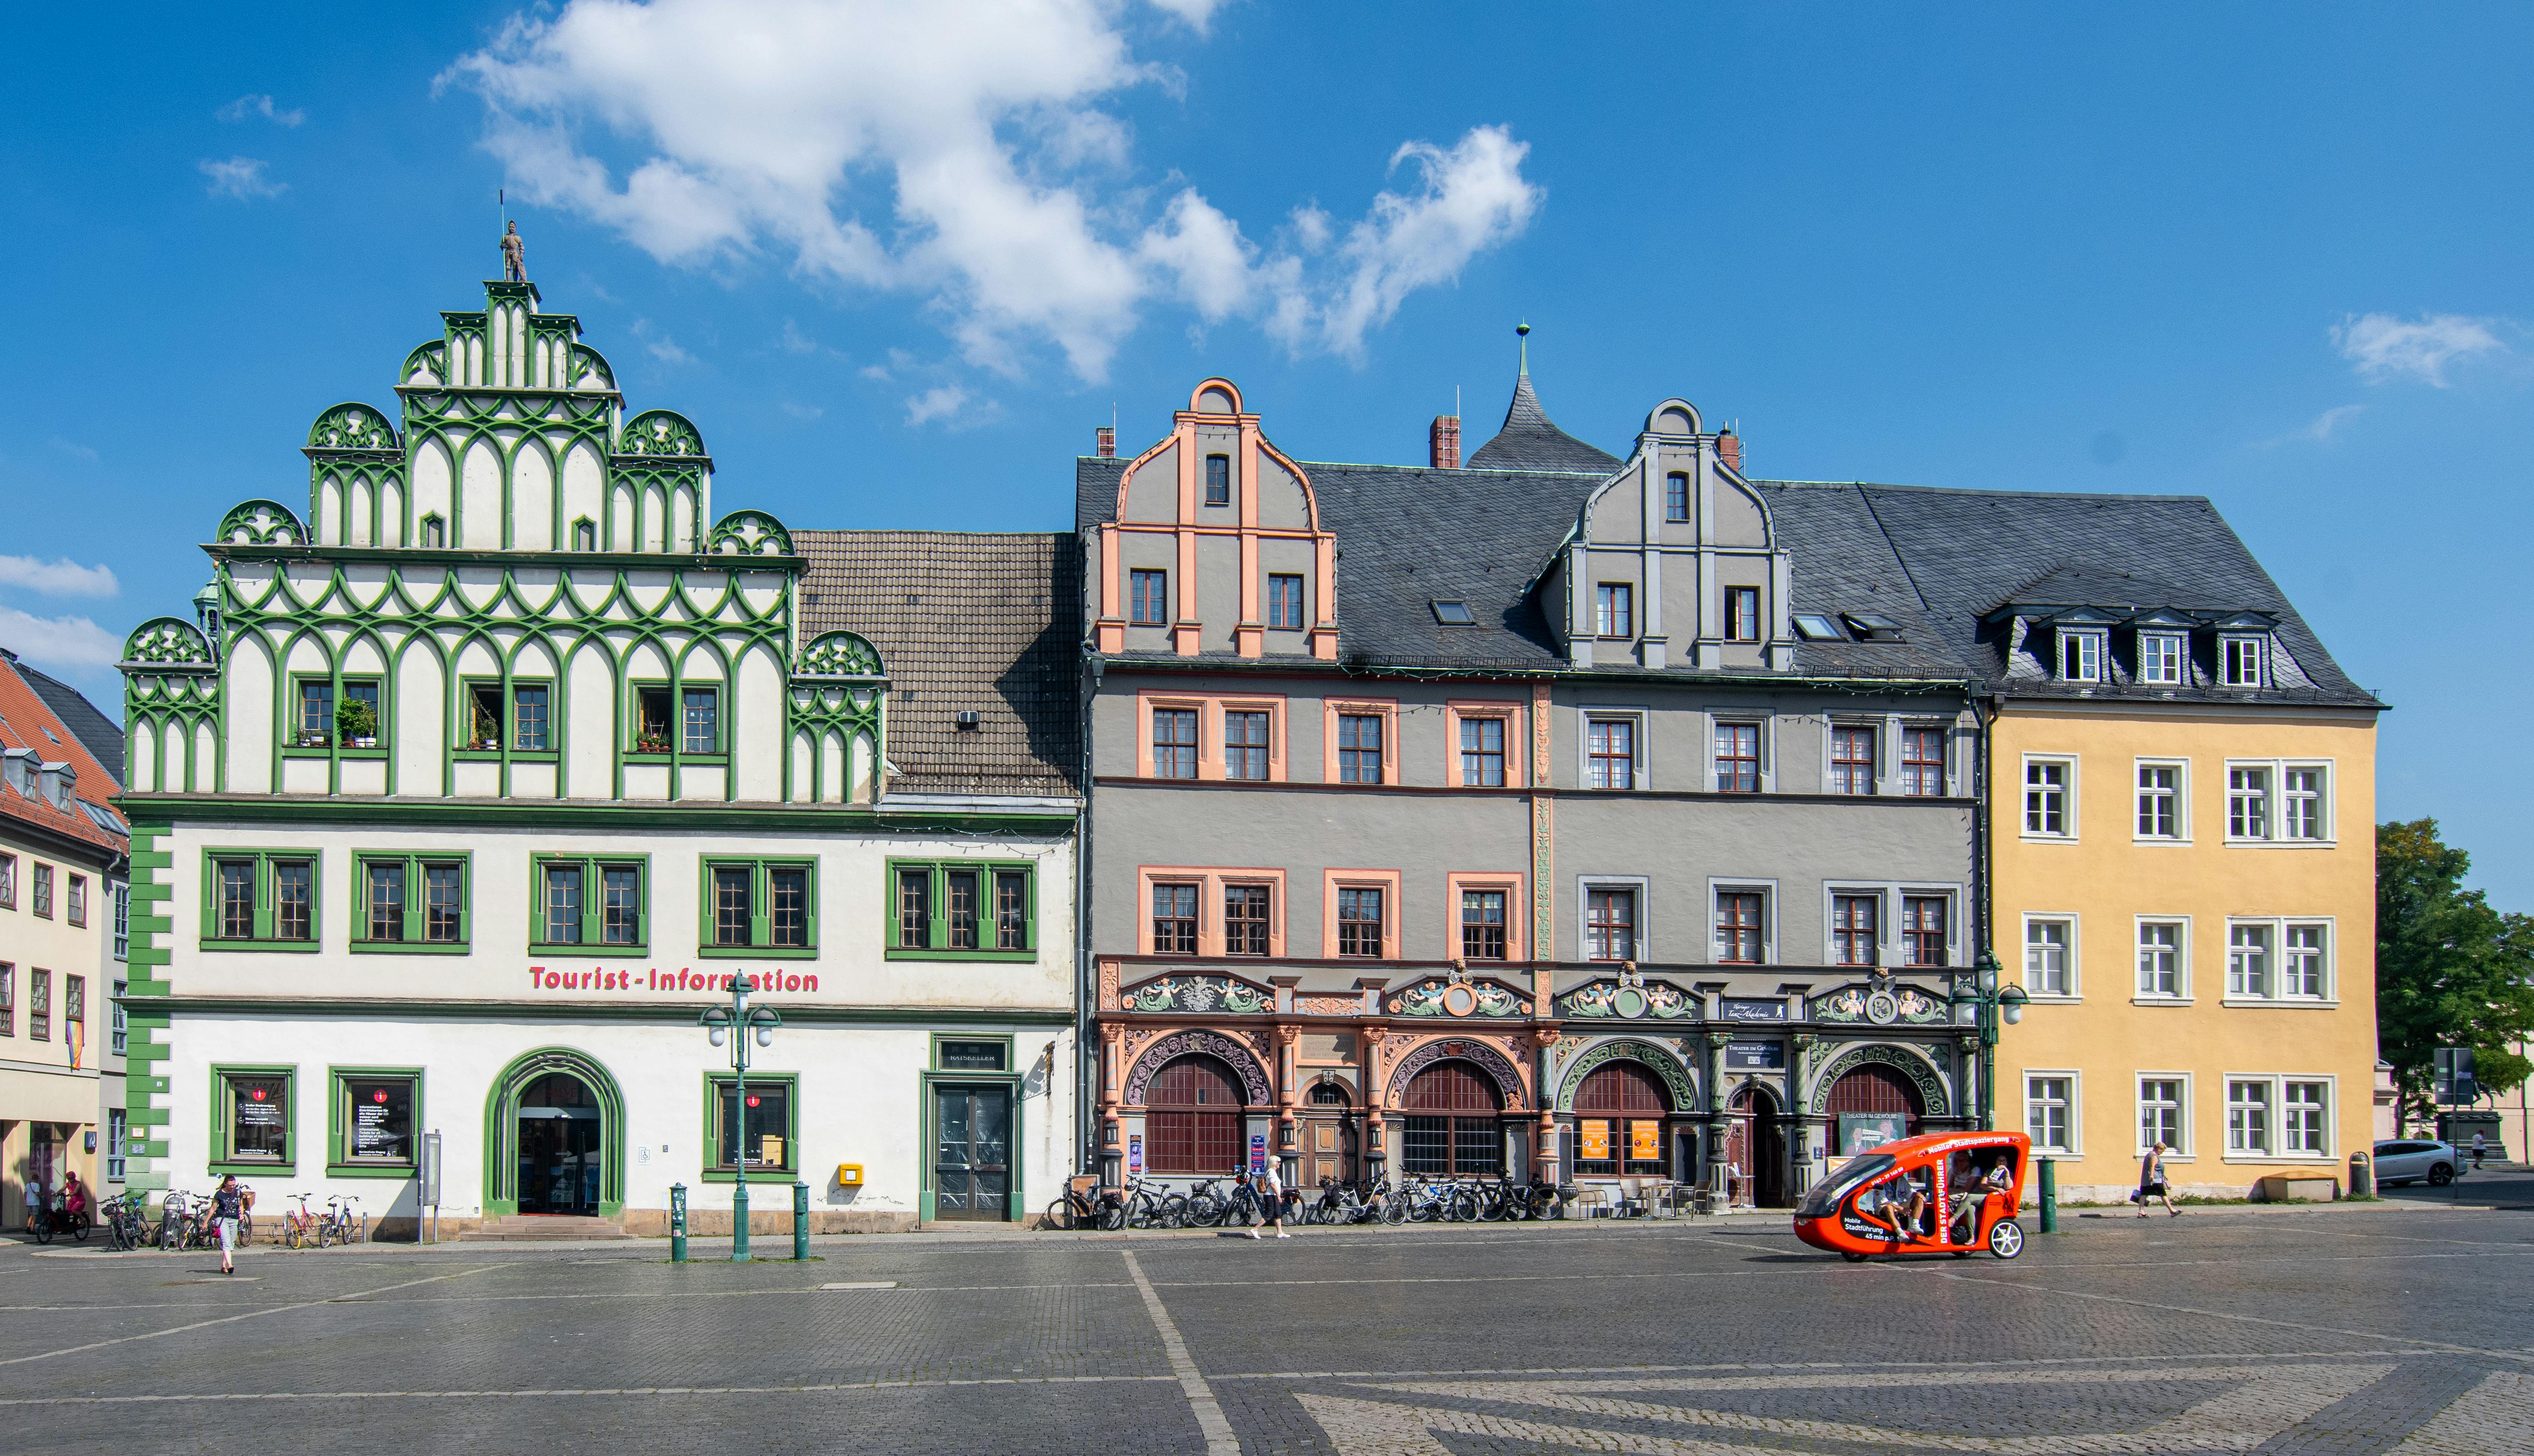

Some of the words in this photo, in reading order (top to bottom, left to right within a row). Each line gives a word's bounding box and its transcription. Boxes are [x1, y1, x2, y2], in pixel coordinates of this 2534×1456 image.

[1728, 1007, 1769, 1019] Tanz-Akademie
[1927, 1143, 1952, 1154] Mobiler
[1955, 1137, 2009, 1148] Stadtspaziergang
[1845, 1223, 1883, 1234] Stadtführung
